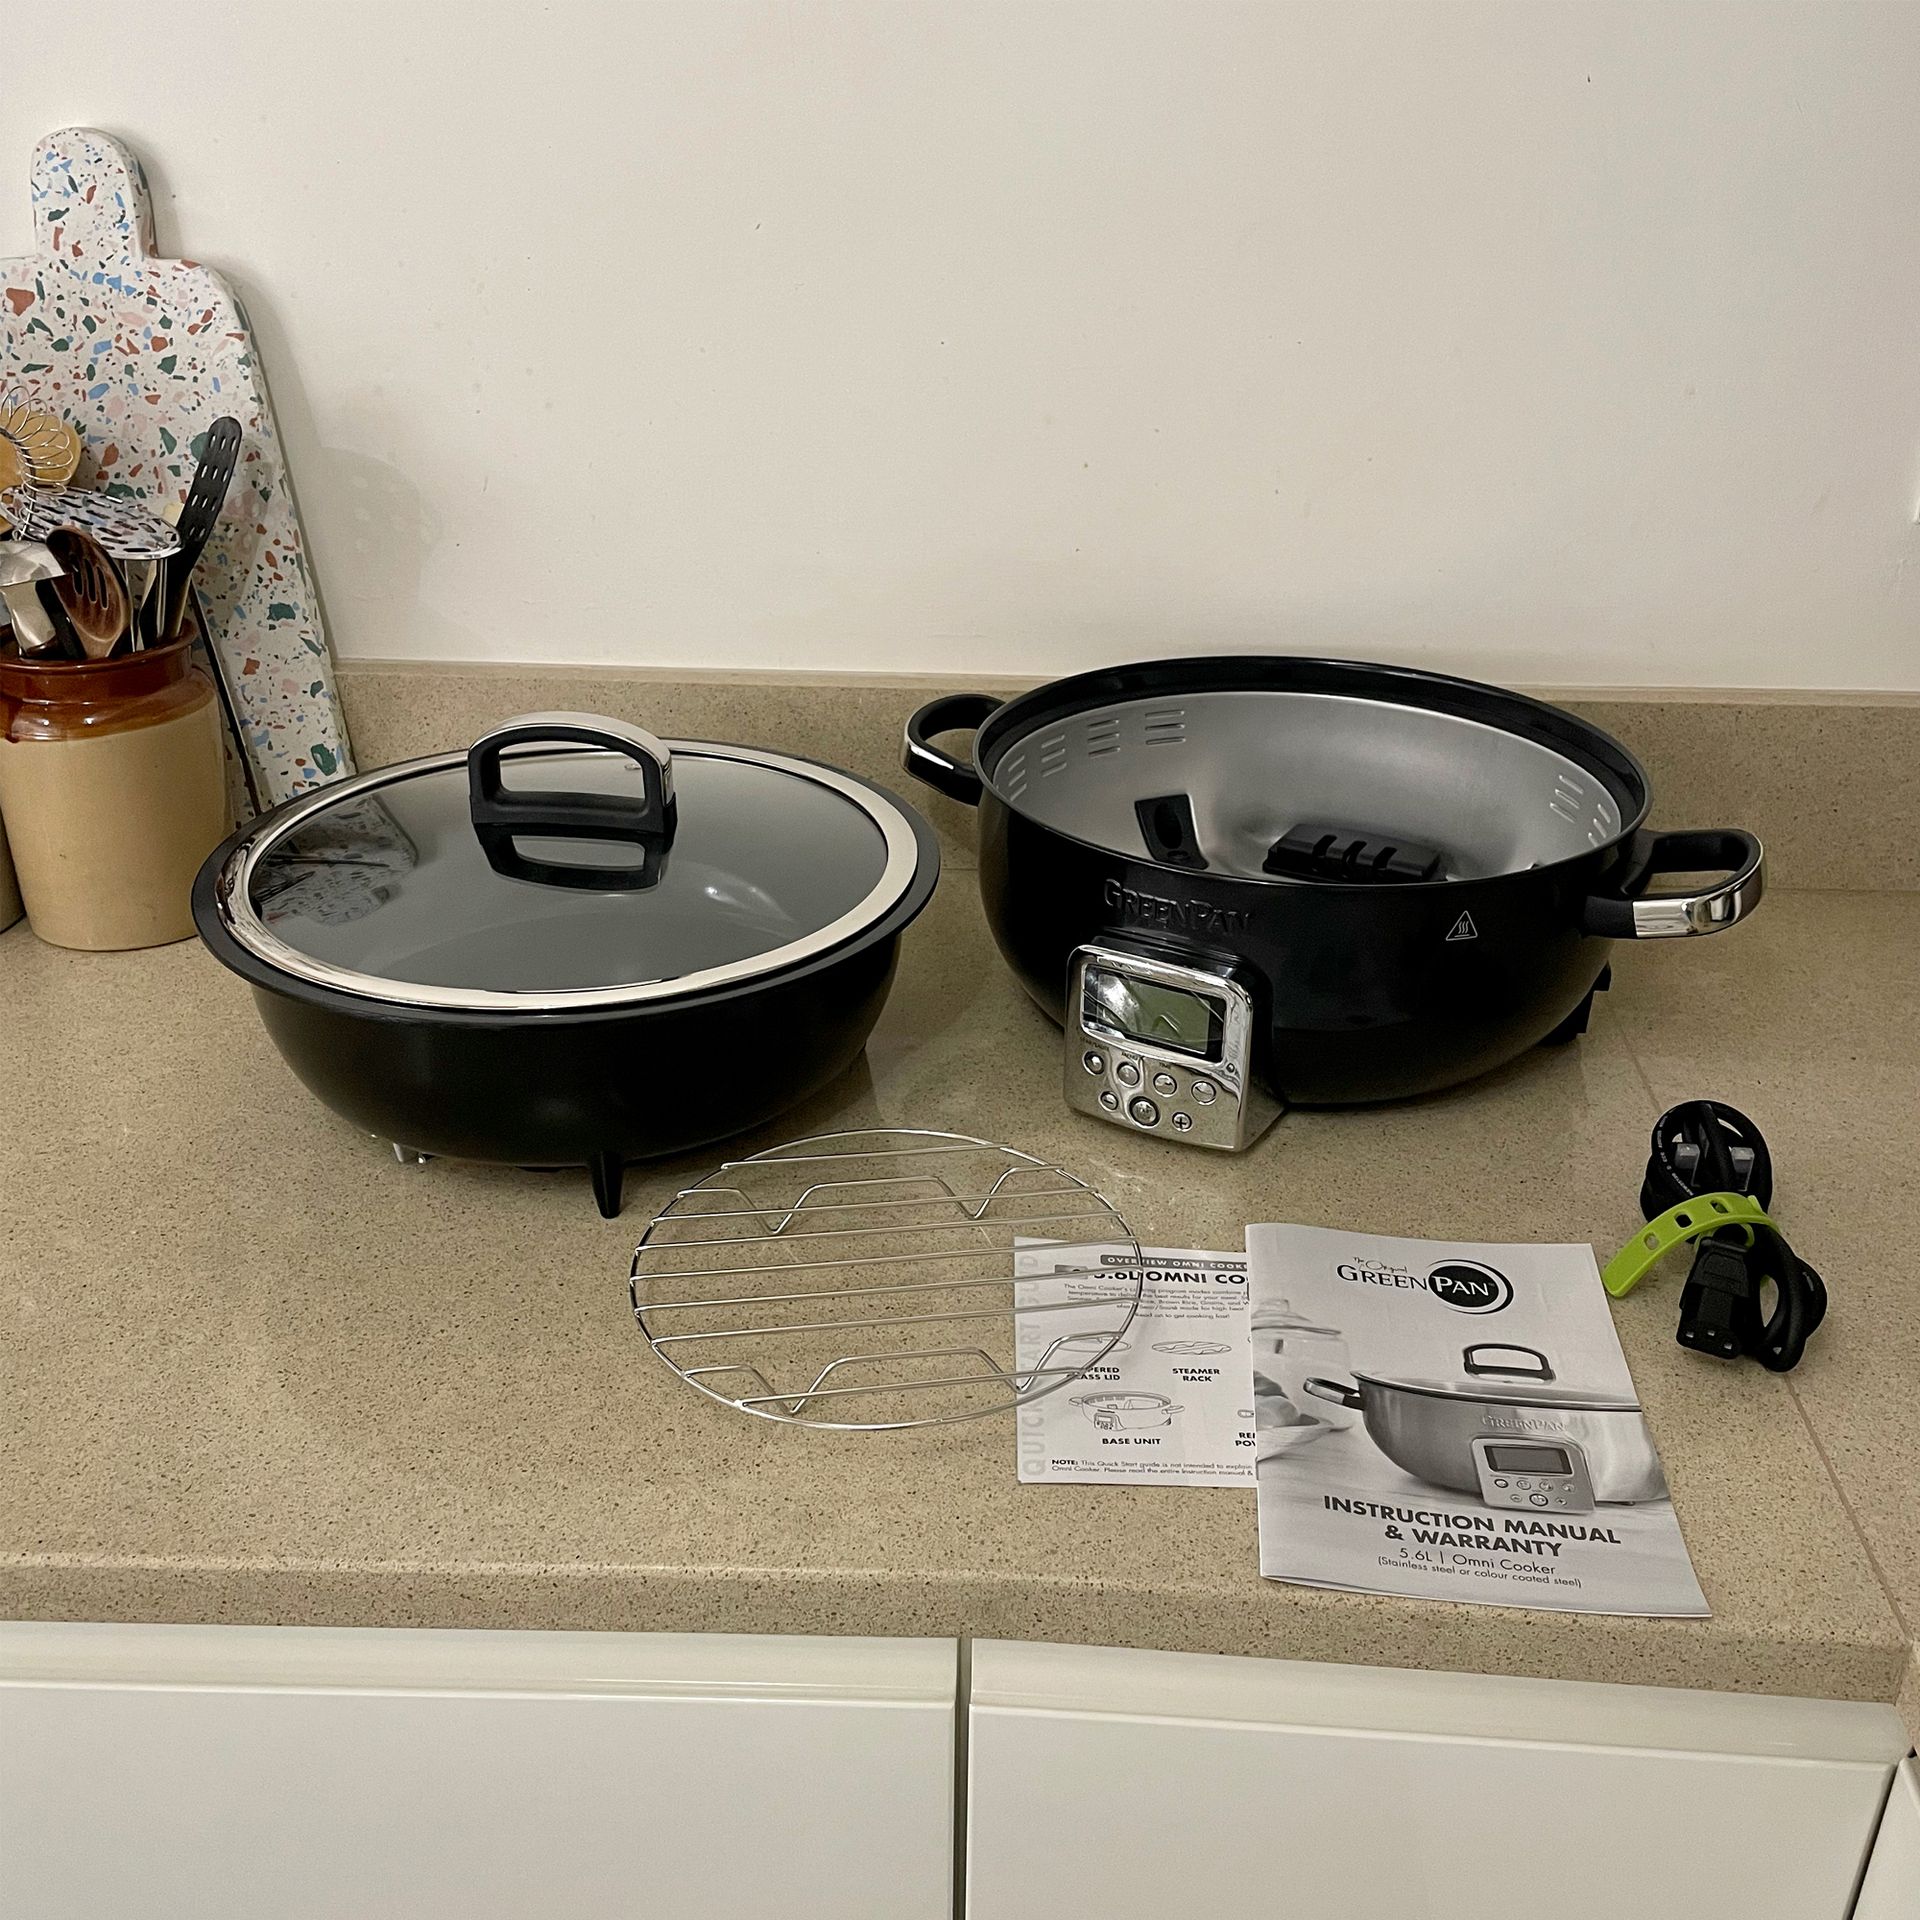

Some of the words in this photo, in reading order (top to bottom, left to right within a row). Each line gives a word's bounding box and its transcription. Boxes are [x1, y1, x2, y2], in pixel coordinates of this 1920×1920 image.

[1145, 1271, 1207, 1283] OMNI
[1215, 1274, 1247, 1284] CO
[1324, 1495, 1495, 1532] INSTRUCTION
[1504, 1519, 1621, 1544] MANUAL
[1384, 1525, 1405, 1541] &
[1412, 1528, 1562, 1557] WARRANTY
[1378, 1556, 1428, 1571] (Stainless
[1431, 1566, 1456, 1574] steel
[1460, 1568, 1470, 1576] or
[1474, 1569, 1508, 1580] colour
[1512, 1574, 1550, 1584] coated
[1554, 1578, 1582, 1589] steel)
[1400, 1548, 1433, 1562] 5.6L
[1452, 1554, 1495, 1568] Omni
[1499, 1559, 1556, 1575] Cooker
